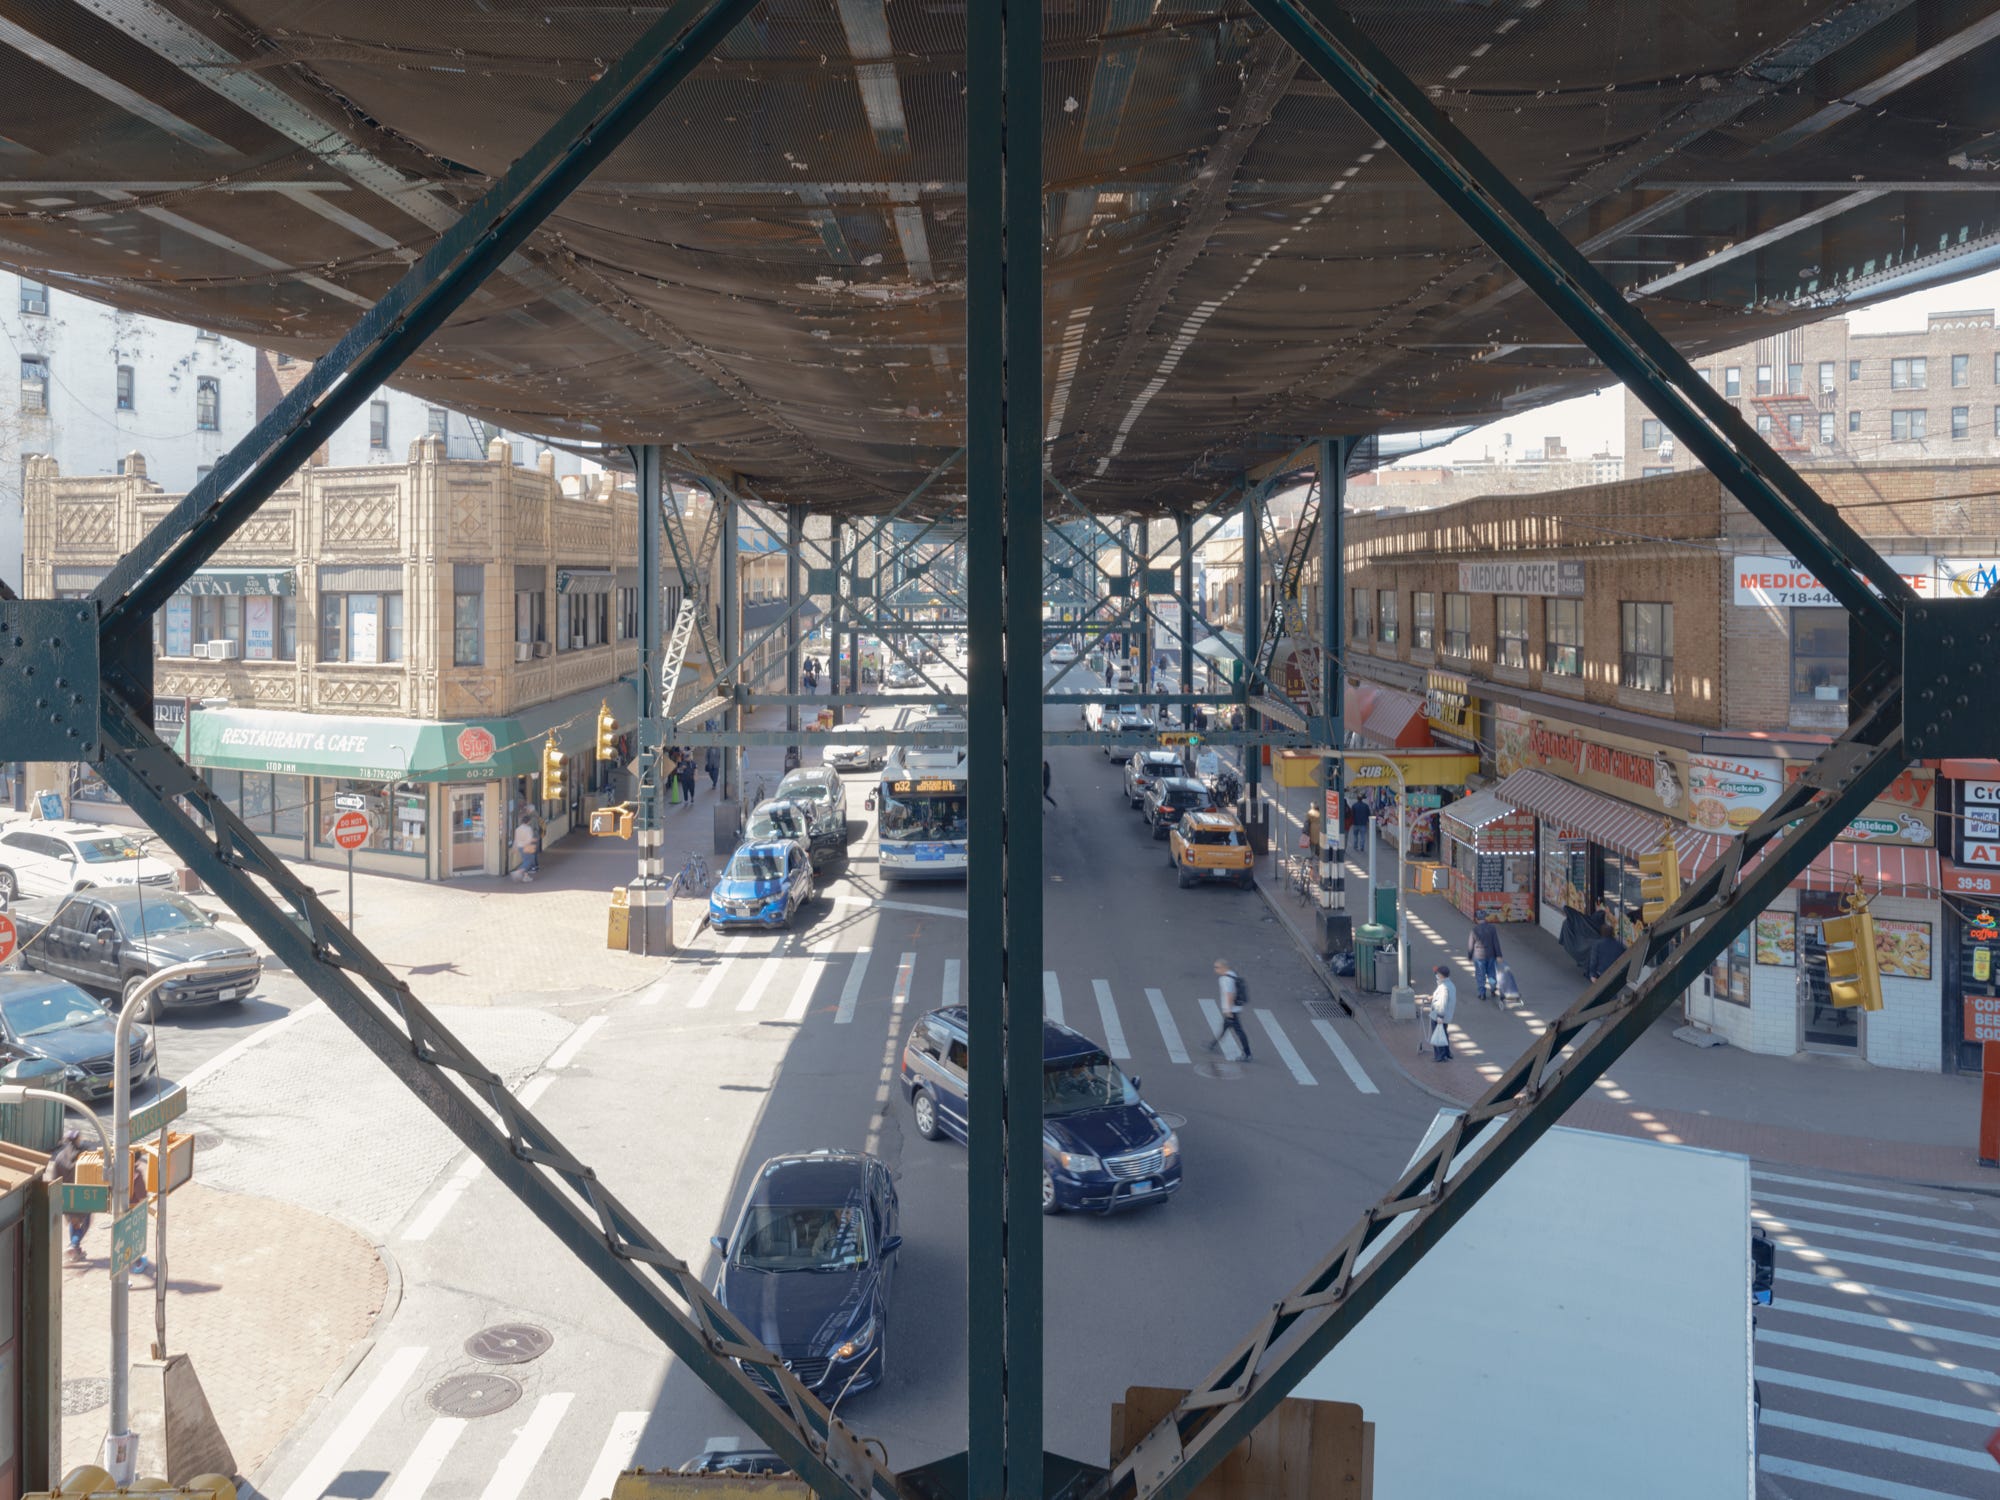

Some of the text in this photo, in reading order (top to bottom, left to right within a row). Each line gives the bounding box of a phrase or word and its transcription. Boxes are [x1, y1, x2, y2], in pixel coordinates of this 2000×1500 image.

[1471, 565, 1514, 592] MEDICAL
[1517, 565, 1555, 592] OFFICE
[1740, 573, 1825, 589] MEDICA
[173, 581, 240, 595] NTAL
[221, 727, 368, 753] RESTAURANT & CAFE
[1528, 720, 1655, 790] Kennedy FRIED CHICKEN
[266, 762, 283, 771] STOP
[466, 768, 495, 778] 60-22
[1721, 783, 1760, 793] chicken
[340, 820, 349, 828] DO
[1853, 821, 1894, 832] chicken
[342, 834, 362, 844] ENTER
[1970, 845, 2000, 862] AT
[1957, 877, 1991, 890] 39-58
[1970, 929, 1999, 940] coffee
[83, 1190, 98, 1200] ST
